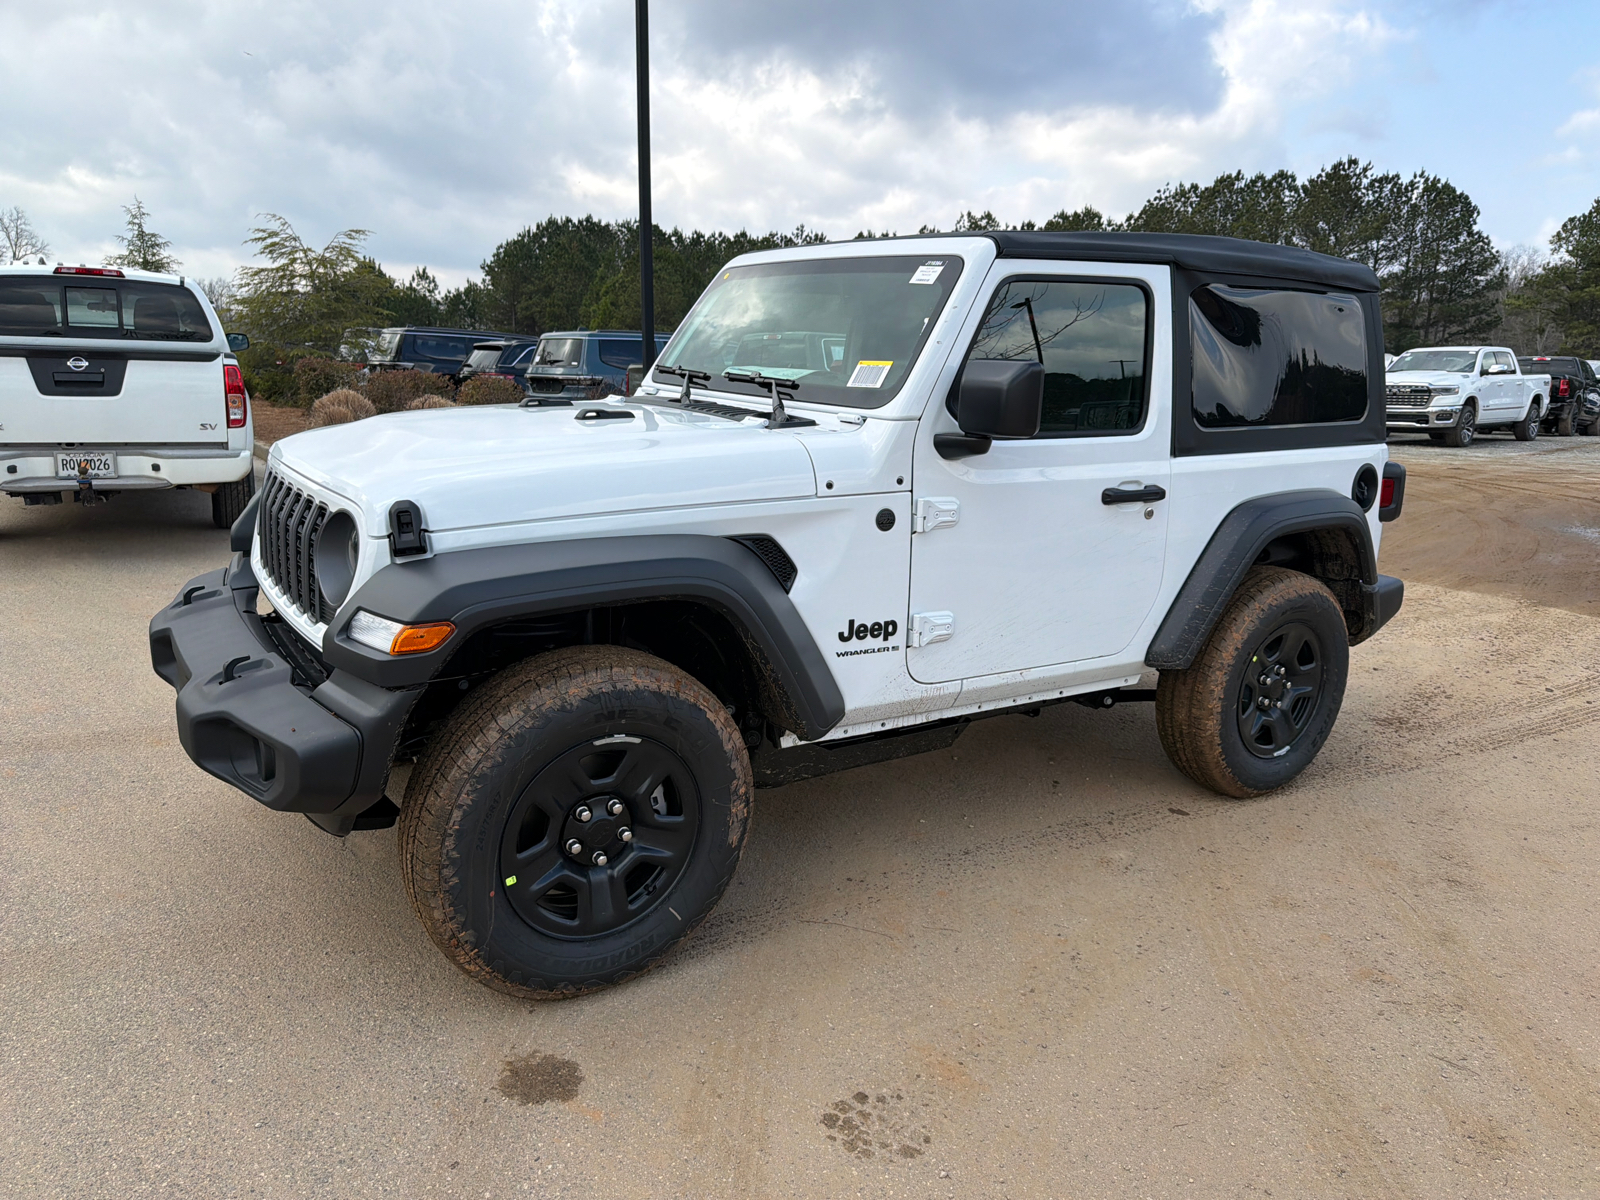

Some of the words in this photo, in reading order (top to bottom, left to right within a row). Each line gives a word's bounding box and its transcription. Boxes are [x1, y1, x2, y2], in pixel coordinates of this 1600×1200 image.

[199, 423, 218, 431] SV
[838, 618, 898, 643] Jeep
[835, 646, 890, 658] WRANGLER
